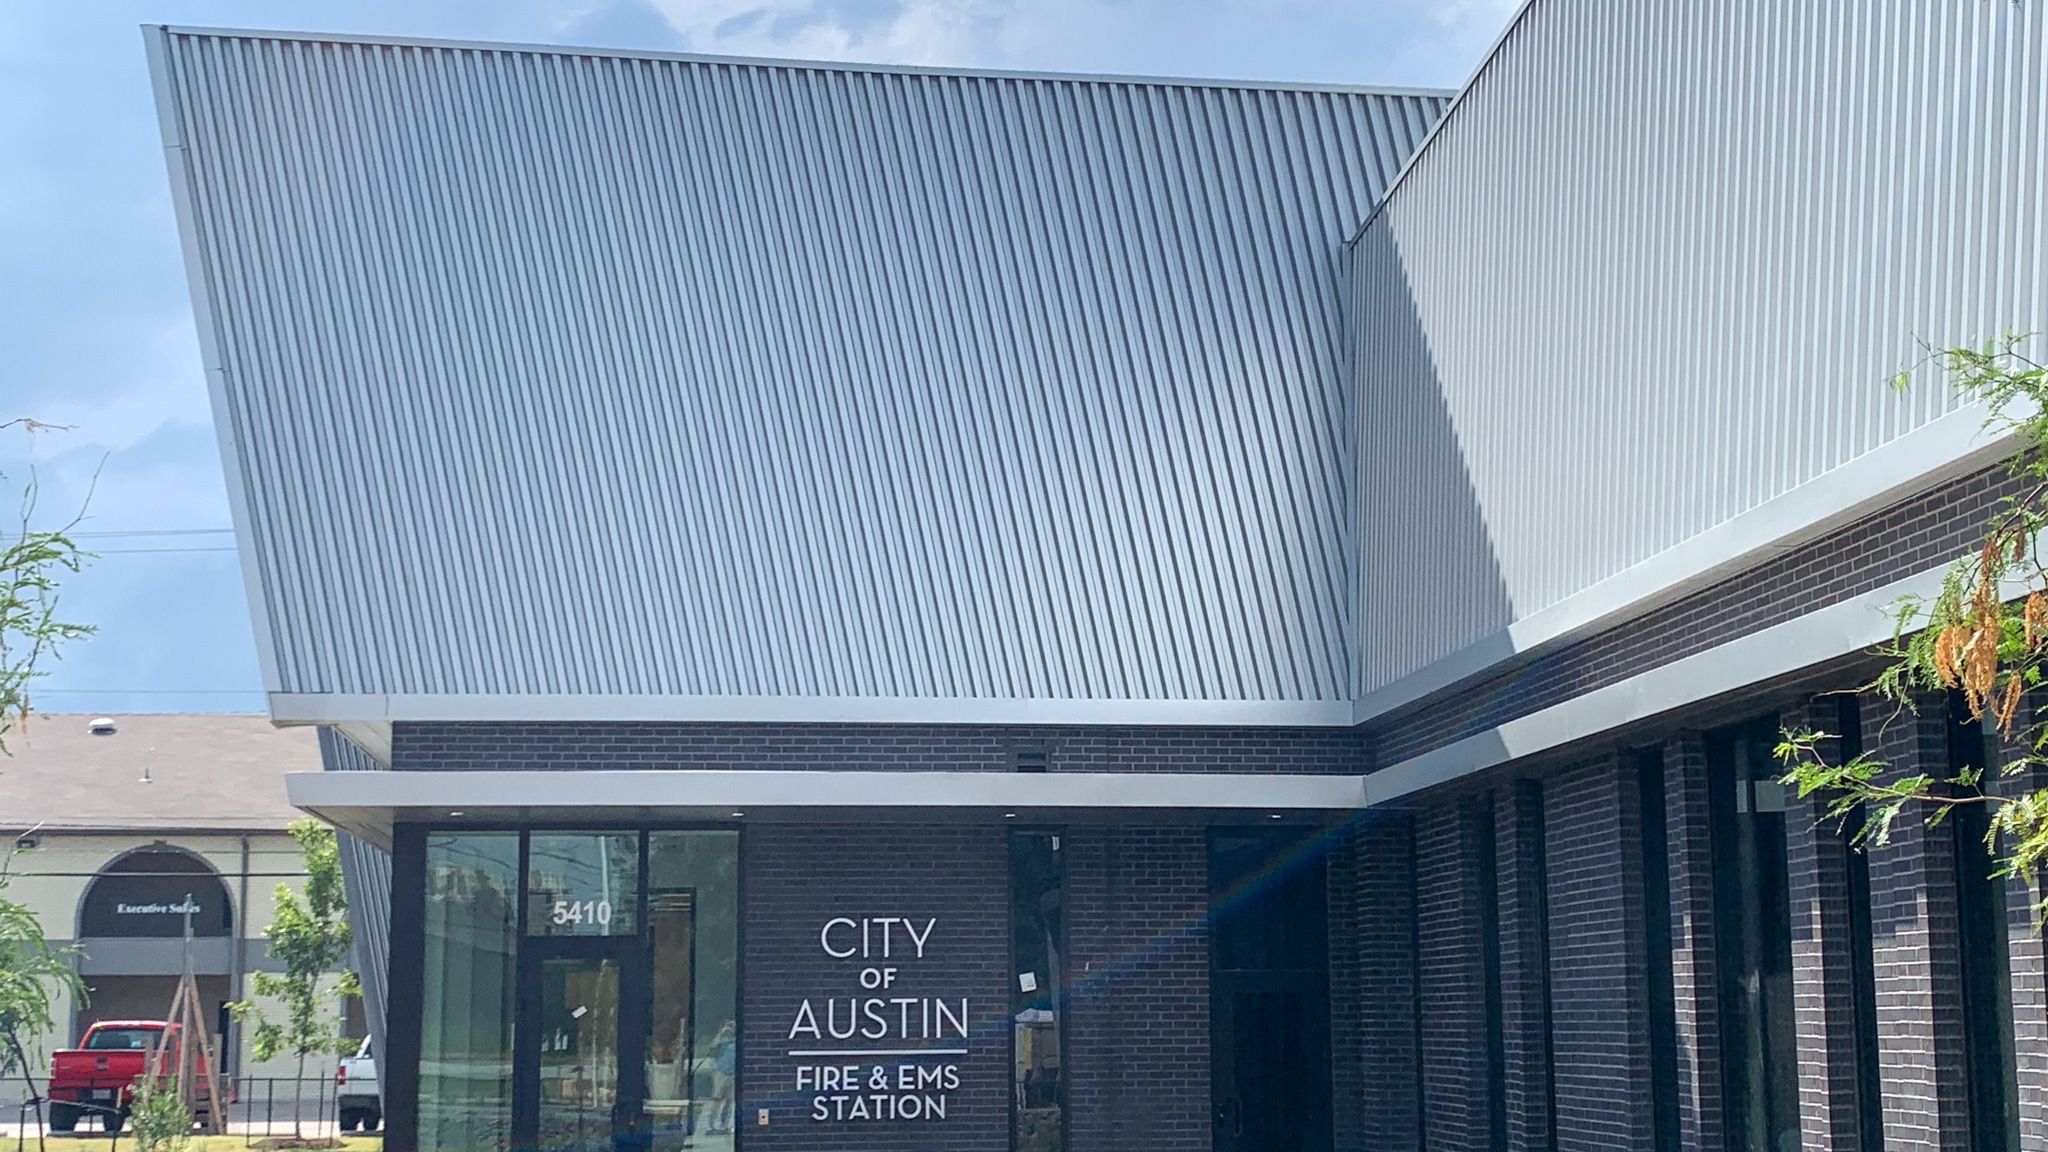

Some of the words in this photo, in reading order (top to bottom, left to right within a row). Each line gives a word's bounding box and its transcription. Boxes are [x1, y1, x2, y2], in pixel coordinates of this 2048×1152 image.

[117, 903, 167, 914] Executive
[553, 900, 612, 925] 5410
[820, 917, 937, 959] CITY
[859, 967, 898, 989] OF
[788, 997, 968, 1040] AUSTIN
[796, 1065, 860, 1091] FIRE
[868, 1065, 889, 1091] &
[898, 1064, 960, 1091] EMS
[812, 1094, 946, 1120] STATION
